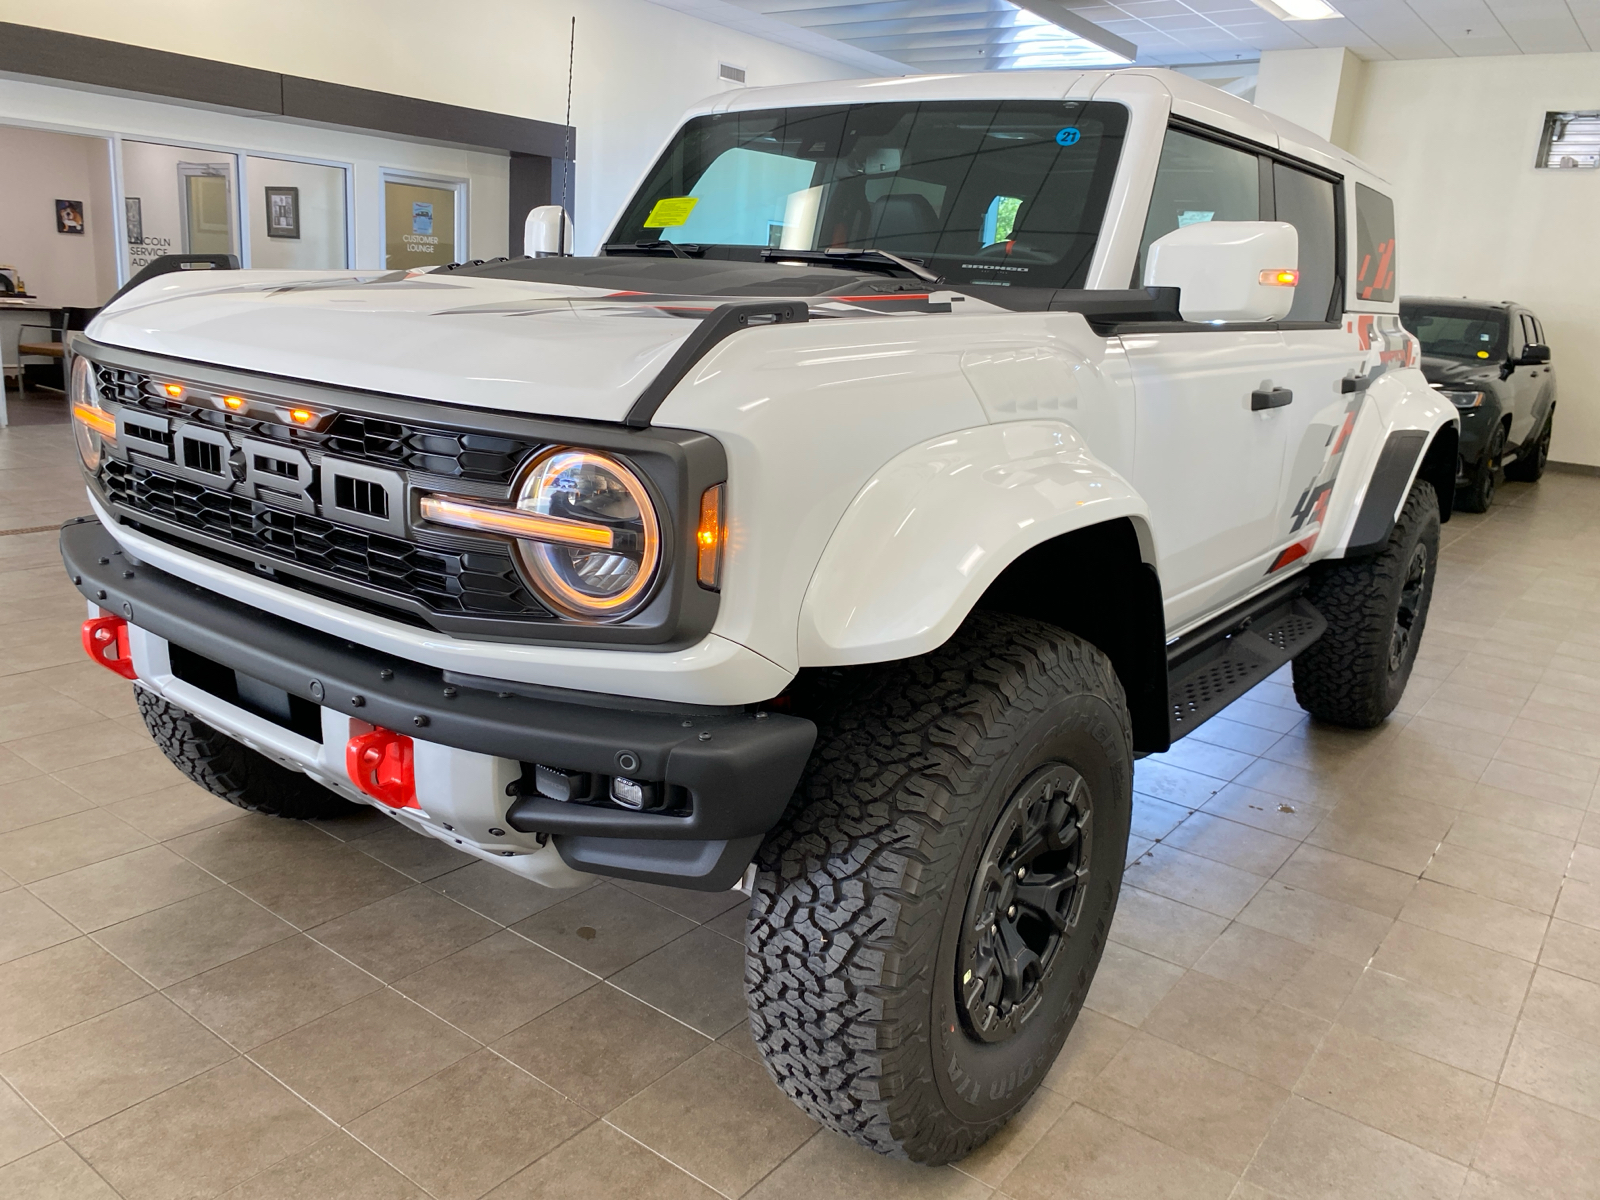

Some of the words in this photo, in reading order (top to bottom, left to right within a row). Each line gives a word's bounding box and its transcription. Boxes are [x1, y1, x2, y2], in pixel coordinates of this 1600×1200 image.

[1060, 131, 1077, 142] 21
[131, 236, 171, 247] NCOLN
[402, 234, 439, 244] CUSTOMER
[130, 247, 168, 256] SERVICE
[406, 244, 434, 253] LOUNGE
[961, 263, 1029, 272] BRONCO
[116, 407, 407, 538] FORD
